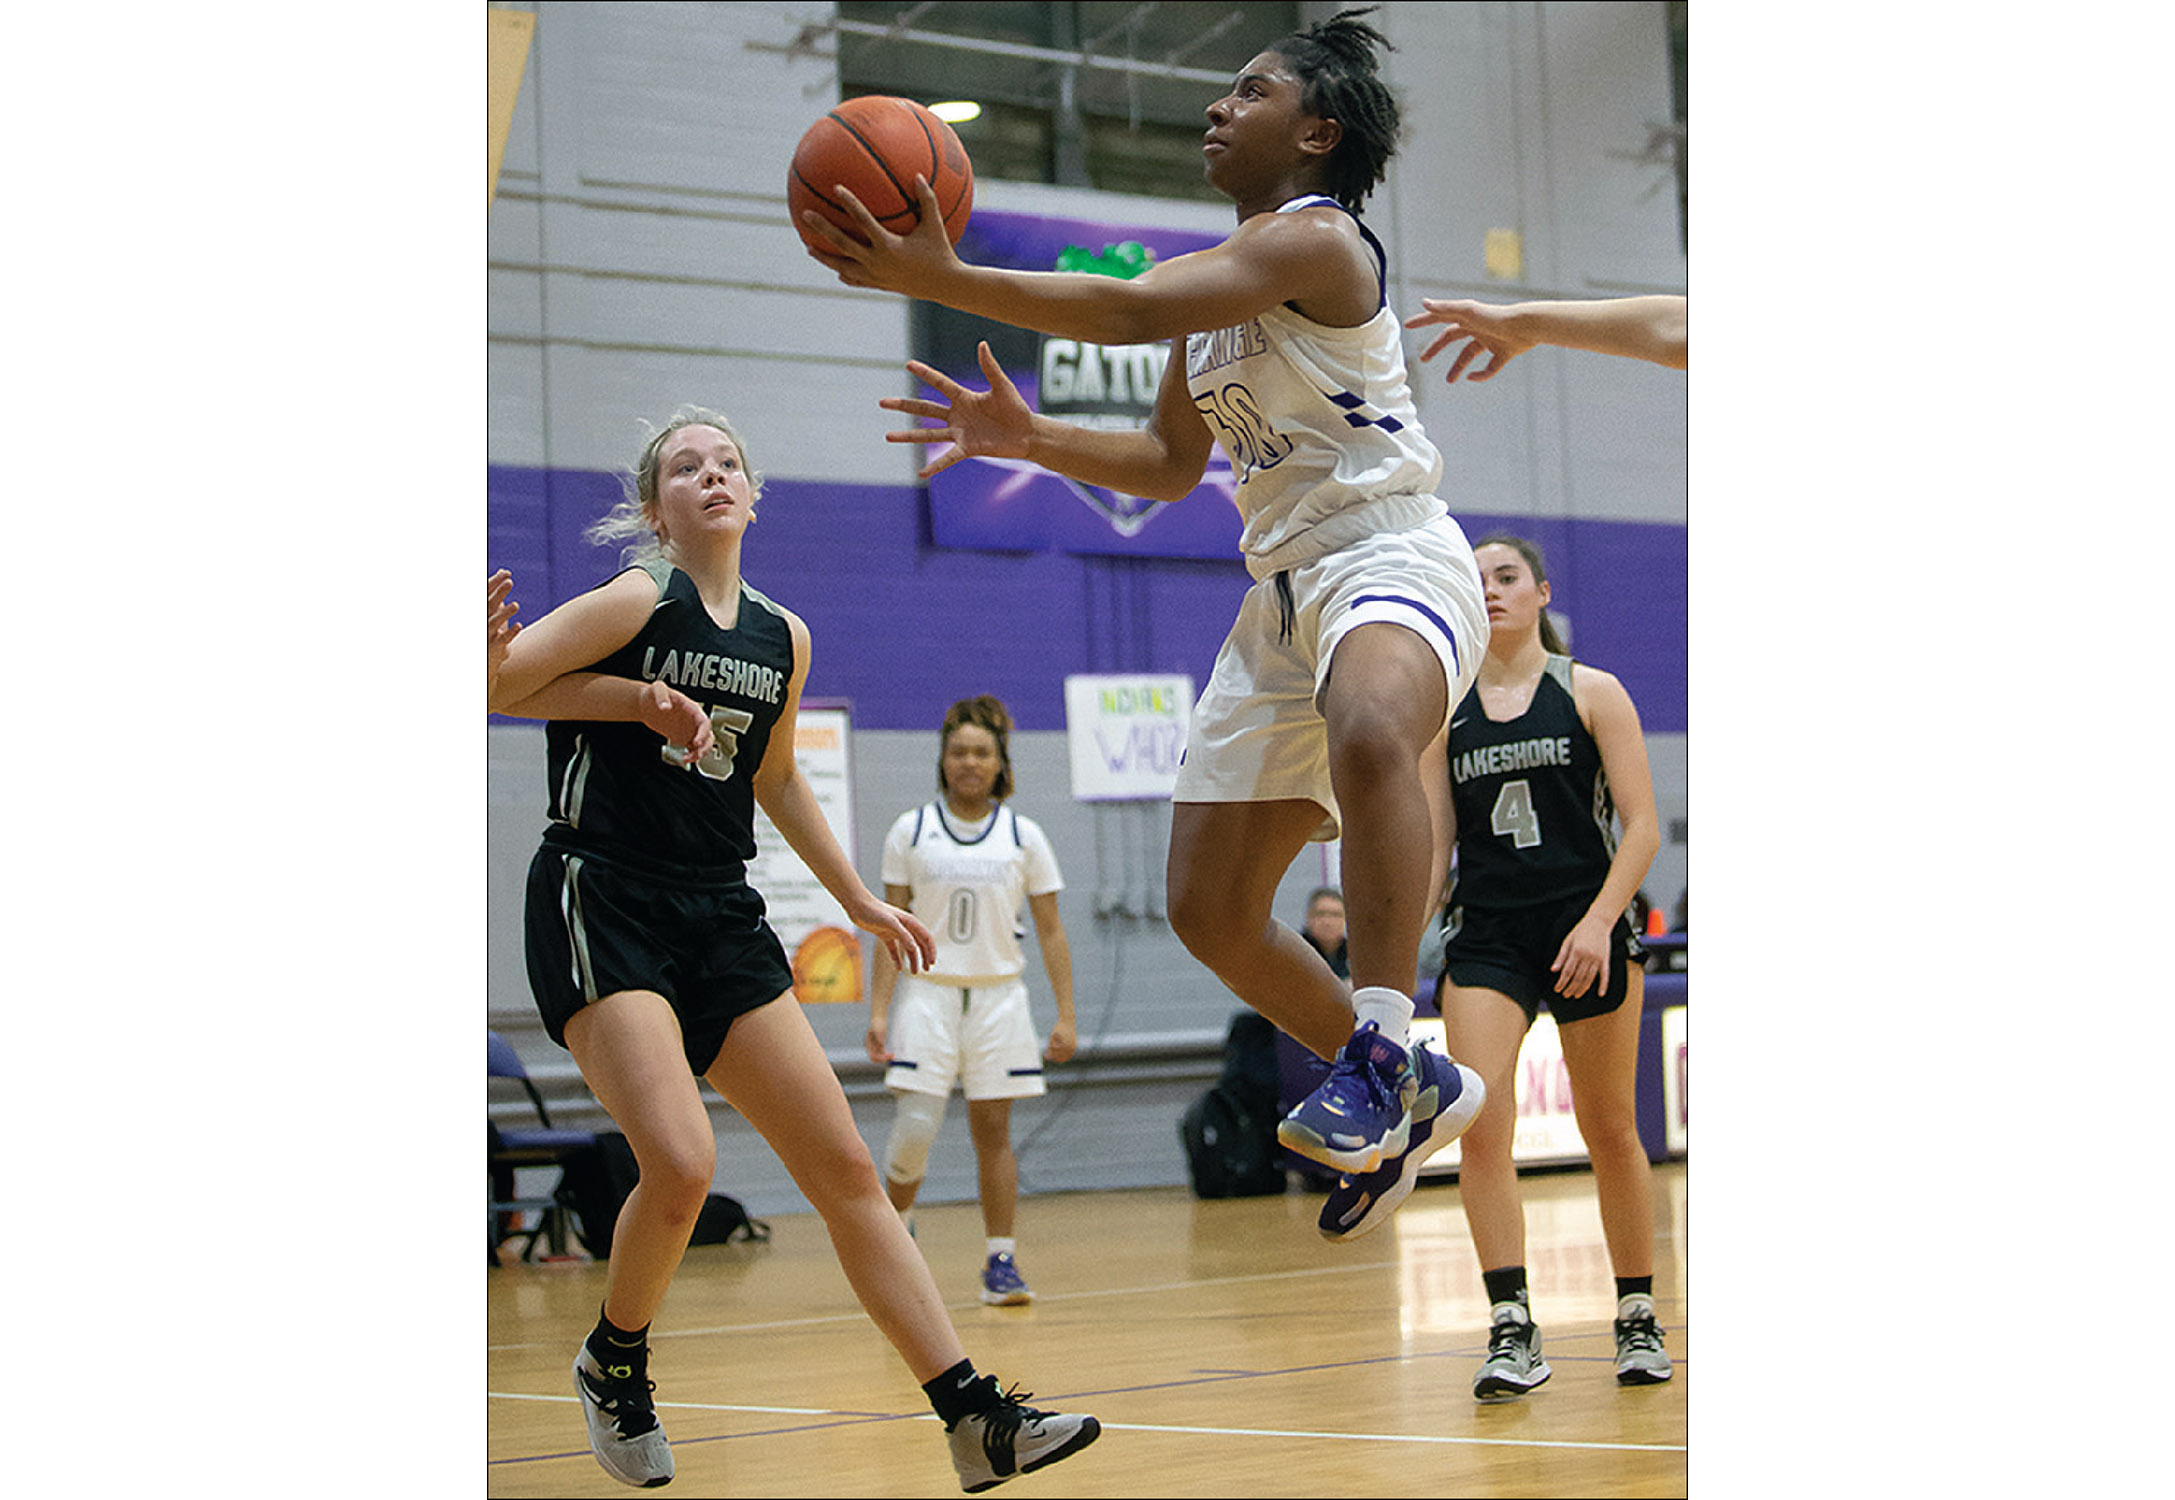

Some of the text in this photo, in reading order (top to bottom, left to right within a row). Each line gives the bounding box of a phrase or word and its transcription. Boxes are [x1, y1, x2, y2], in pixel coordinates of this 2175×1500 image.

[1042, 338, 1170, 404] GATO
[642, 646, 784, 705] LAKESHORE
[1453, 737, 1571, 785] LAKESHORE
[1490, 779, 1542, 849] 4
[947, 887, 977, 945] 0
